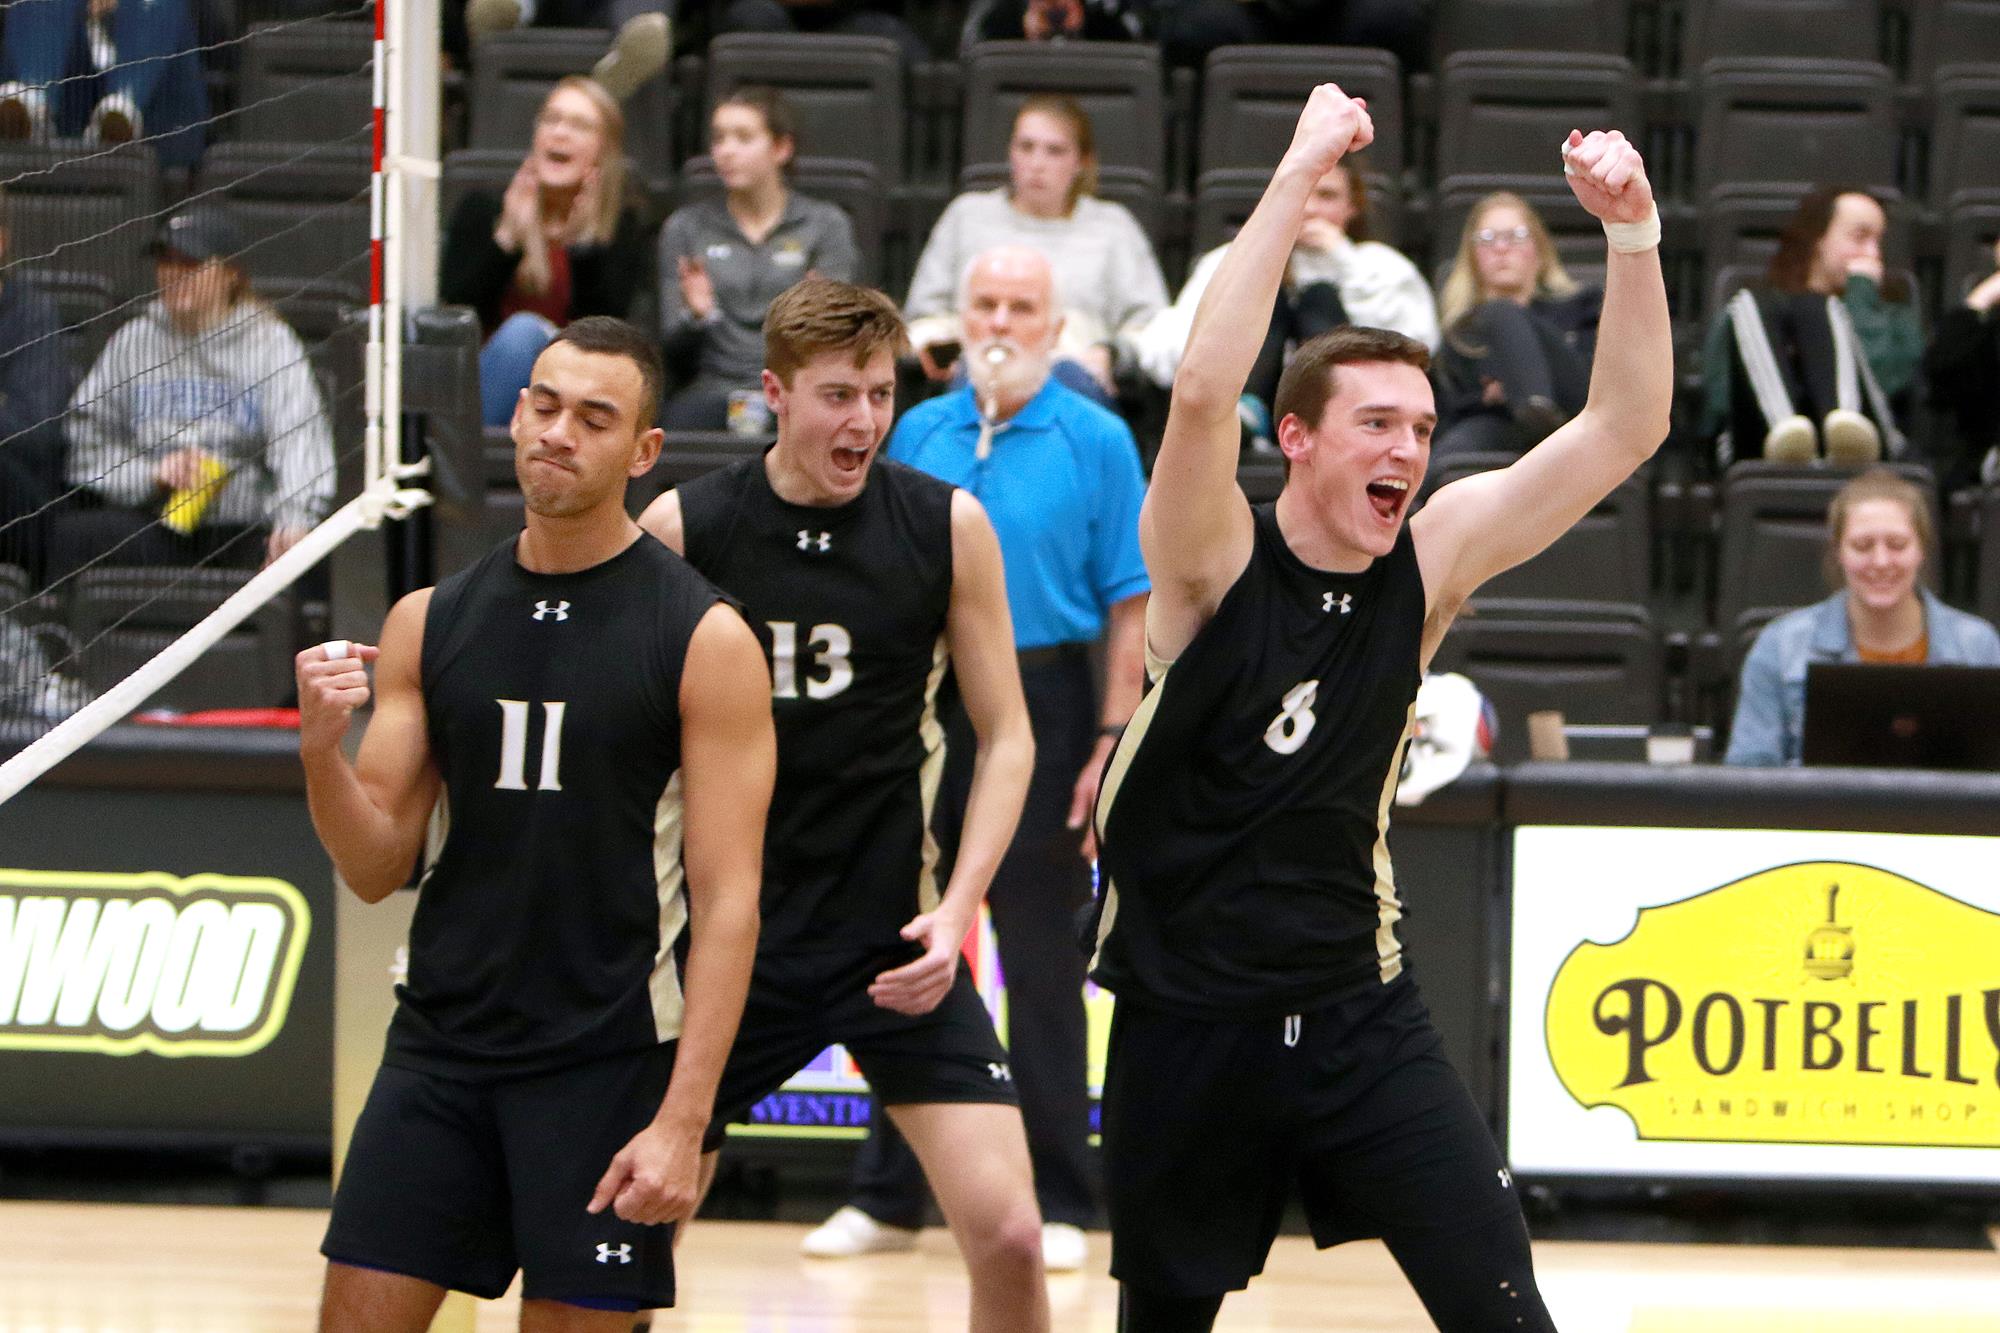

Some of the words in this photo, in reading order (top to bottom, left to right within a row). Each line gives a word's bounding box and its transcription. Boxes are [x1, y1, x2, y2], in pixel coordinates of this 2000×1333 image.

[765, 620, 854, 700] 13
[494, 698, 567, 791] 11
[1668, 1097, 1857, 1119] SANDWICH
[1886, 1101, 1977, 1121] SHOP
